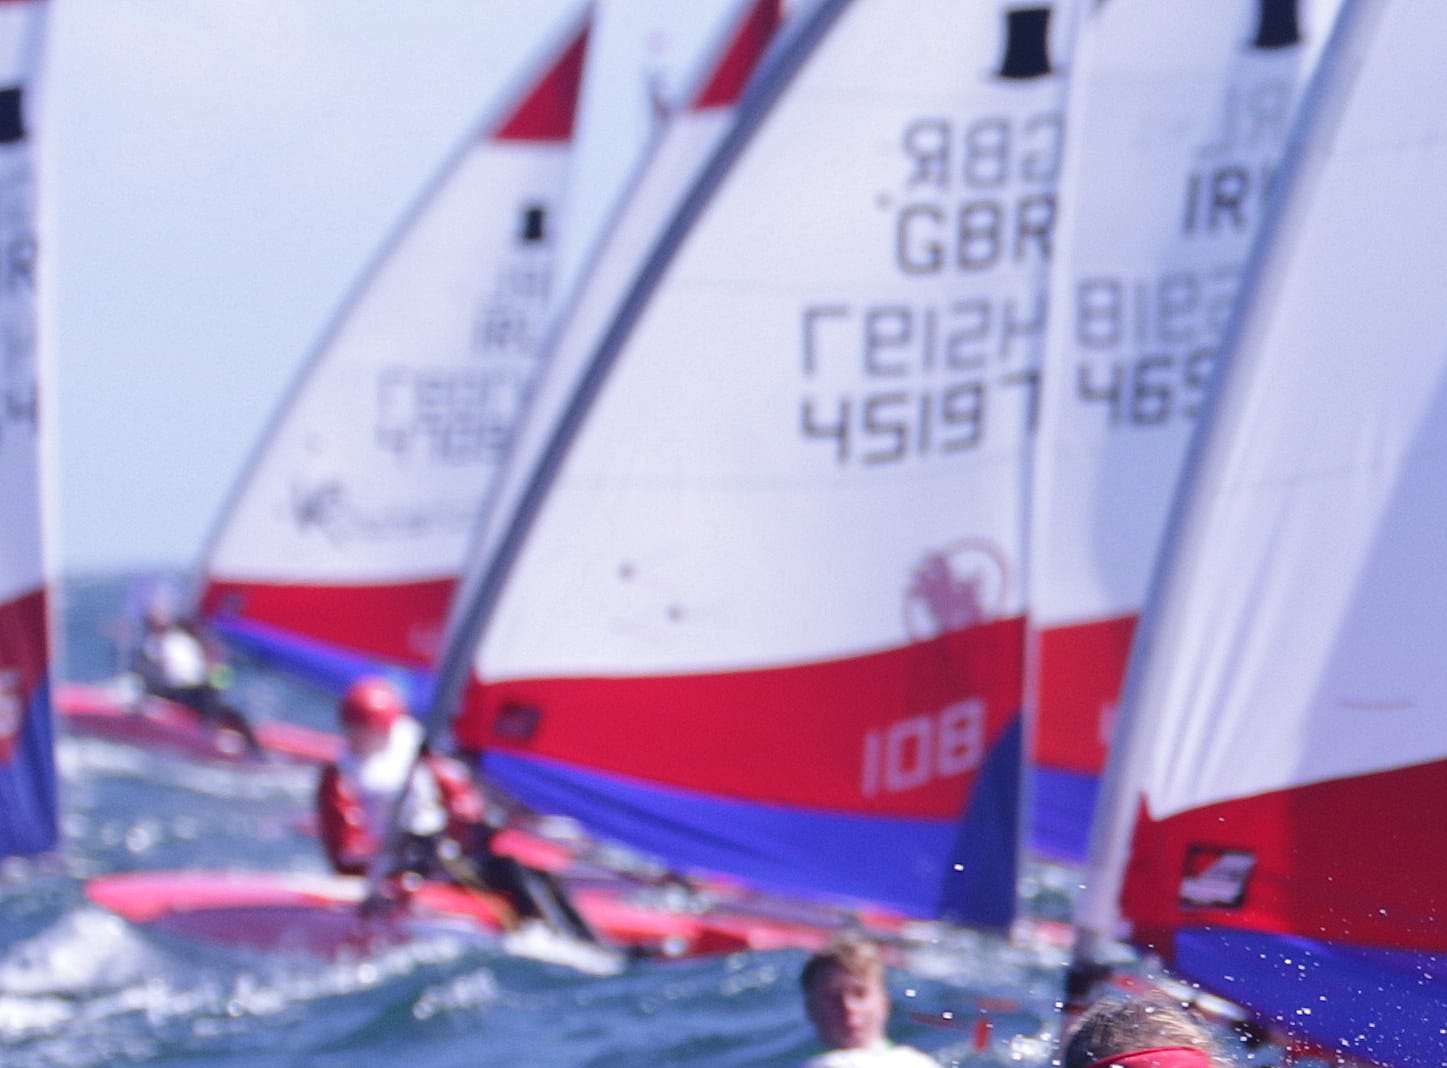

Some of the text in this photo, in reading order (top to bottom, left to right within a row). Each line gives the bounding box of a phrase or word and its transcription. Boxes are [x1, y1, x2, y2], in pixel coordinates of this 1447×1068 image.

[897, 192, 1058, 276] GBR
[801, 369, 1042, 466] 45197
[862, 698, 986, 797] 108
